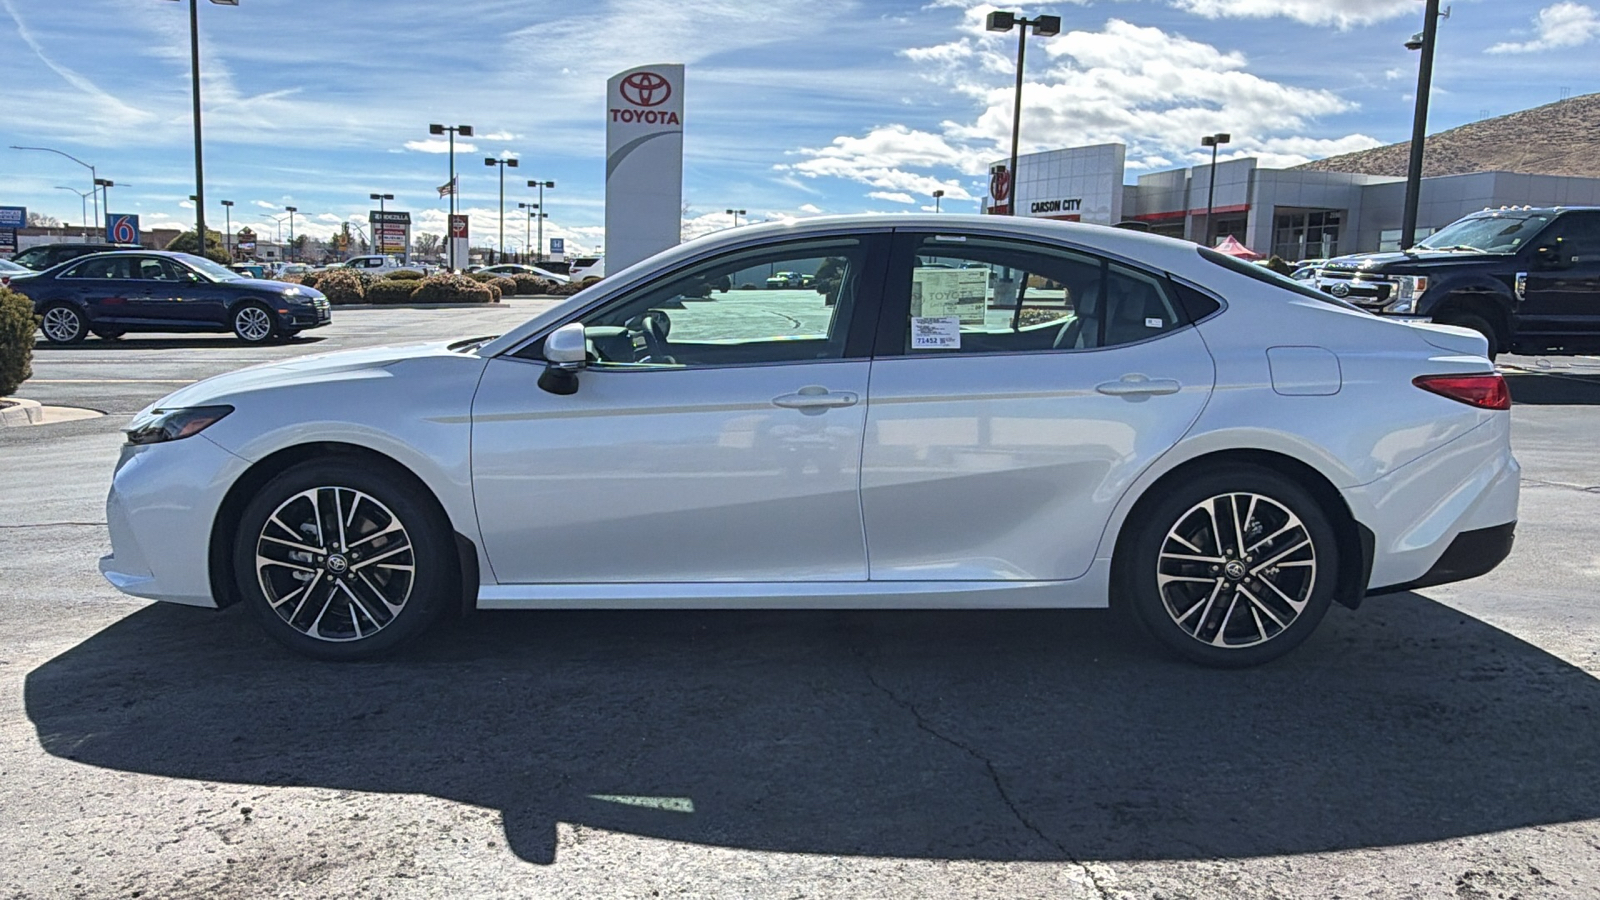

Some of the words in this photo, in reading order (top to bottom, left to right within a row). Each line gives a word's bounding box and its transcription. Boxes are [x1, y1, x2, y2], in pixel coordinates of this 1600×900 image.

[610, 108, 680, 125] TOYOTA
[1031, 200, 1061, 213] CARSON
[1062, 198, 1082, 210] CITY
[113, 214, 135, 243] 6
